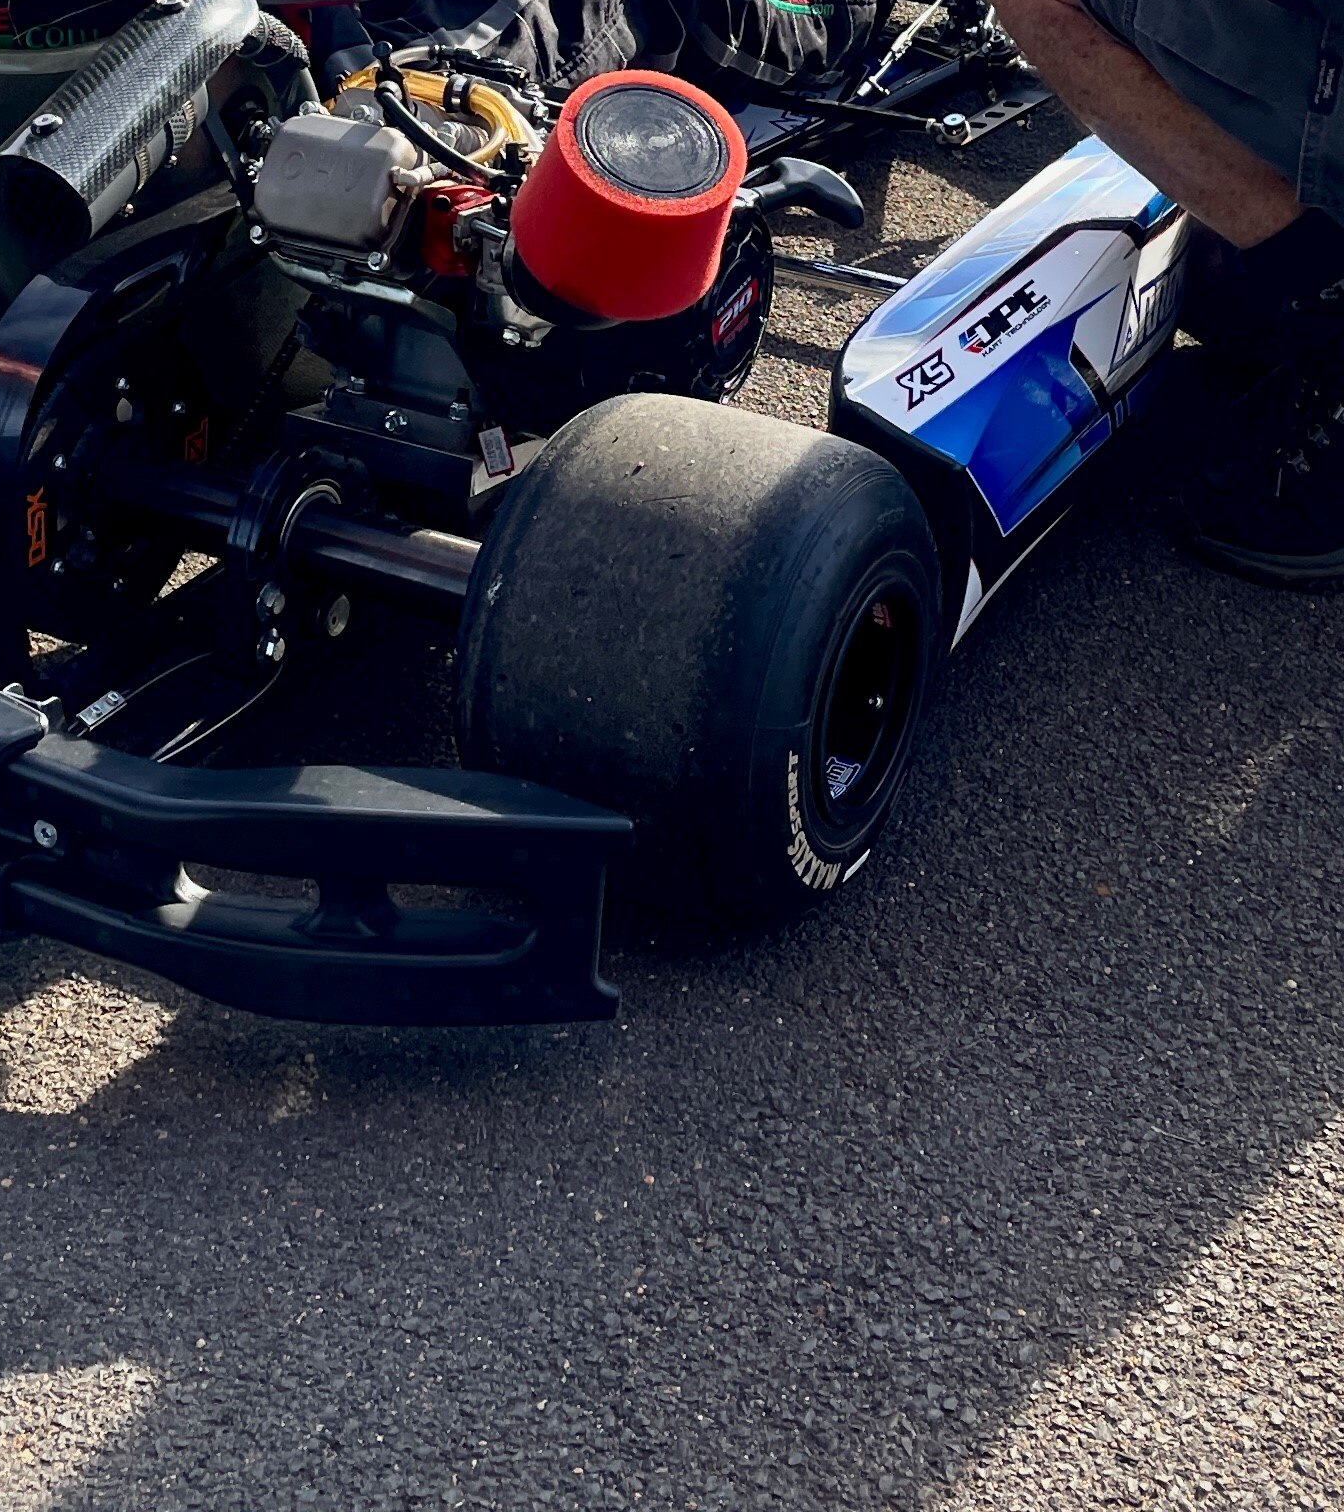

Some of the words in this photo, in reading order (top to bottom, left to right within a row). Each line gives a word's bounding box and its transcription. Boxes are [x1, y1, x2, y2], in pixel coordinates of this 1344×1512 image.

[982, 338, 1003, 357] KART
[1005, 299, 1051, 338] TECHNOLOGY
[788, 750, 802, 834] SPORT
[787, 830, 842, 890] MAXXIS
